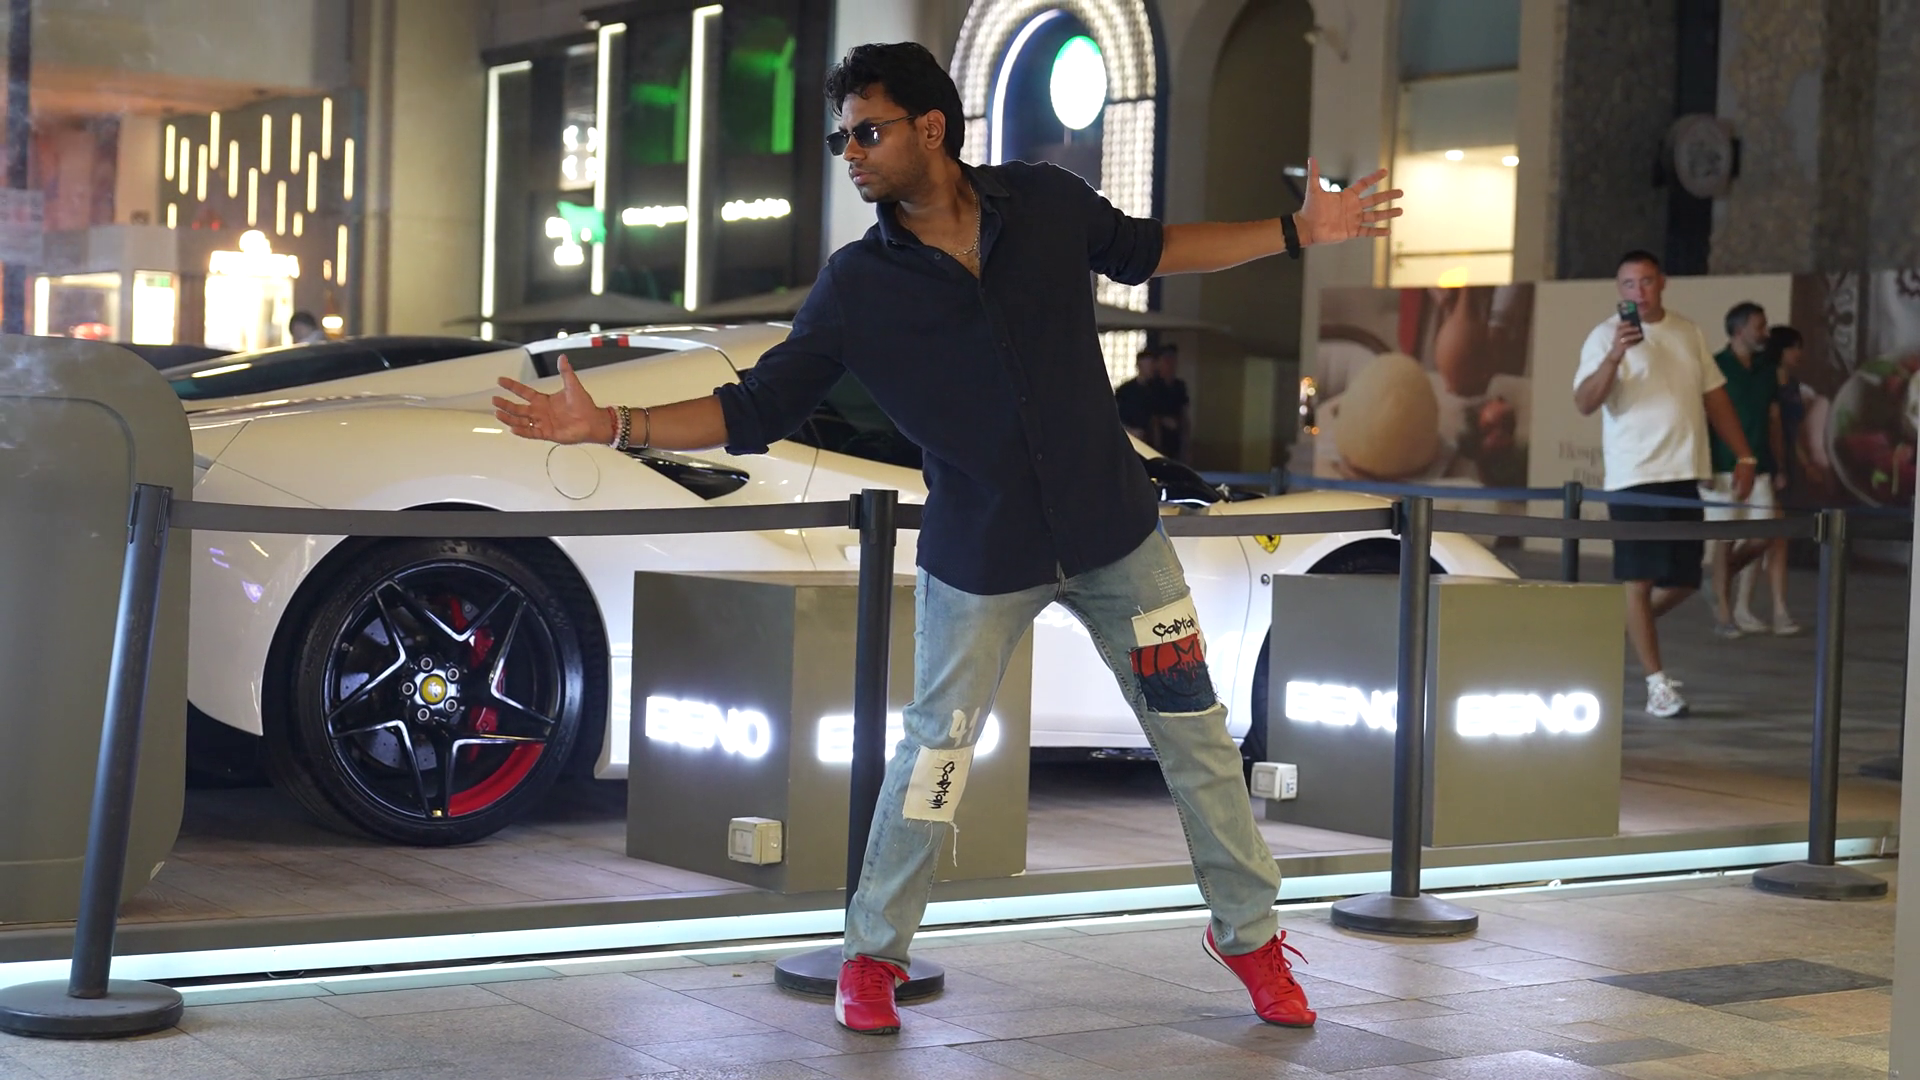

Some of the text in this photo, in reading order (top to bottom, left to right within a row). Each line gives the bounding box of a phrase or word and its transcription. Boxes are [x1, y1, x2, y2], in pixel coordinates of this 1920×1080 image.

[1152, 614, 1197, 639] Capta
[645, 695, 770, 758] BENO
[1456, 692, 1600, 736] BENO
